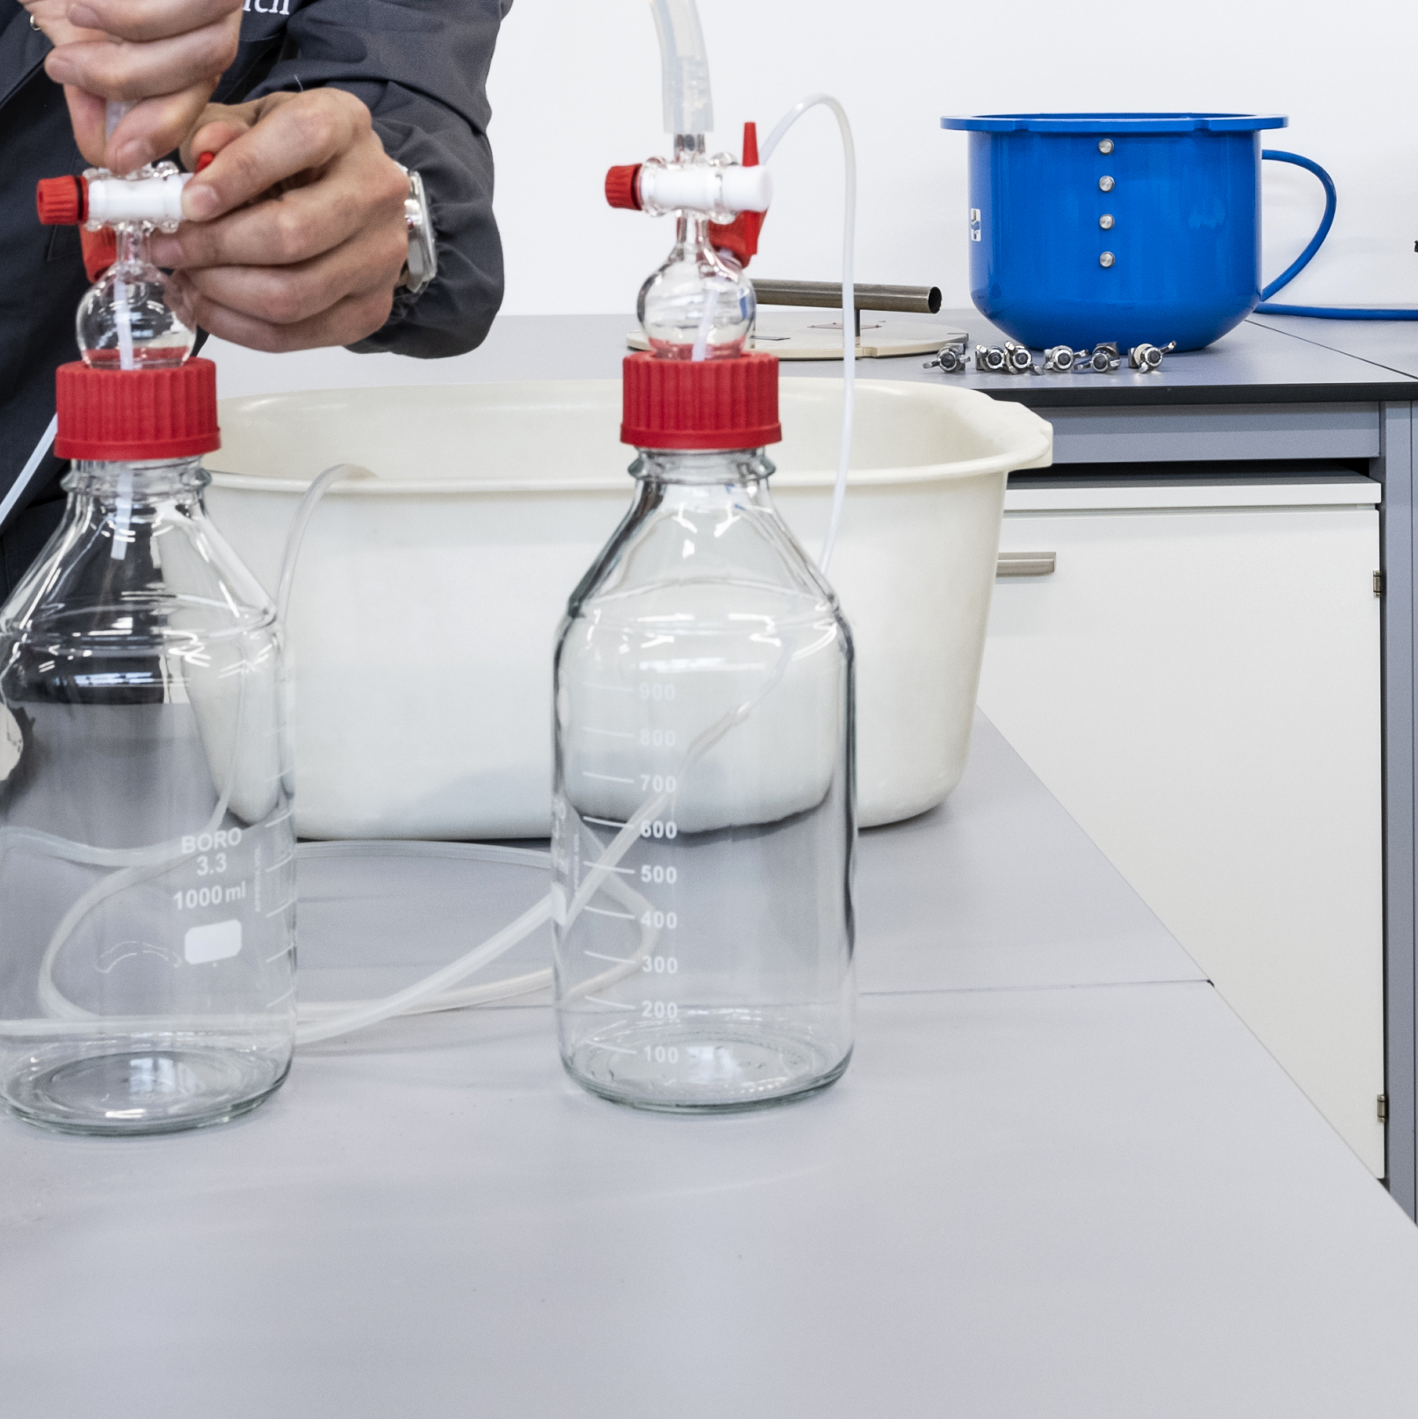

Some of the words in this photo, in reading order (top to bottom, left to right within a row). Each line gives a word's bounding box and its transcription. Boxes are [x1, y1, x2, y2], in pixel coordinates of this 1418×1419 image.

[640, 682, 676, 701] 900
[640, 774, 677, 793] 700
[640, 820, 678, 839] 600
[181, 827, 242, 854] BORO
[196, 853, 227, 876] 3.3
[640, 865, 678, 884] 500
[173, 885, 223, 910] 1000
[226, 881, 246, 902] ml
[641, 910, 678, 929] 400
[642, 956, 678, 974] 300
[642, 1000, 678, 1019] 200
[644, 1045, 679, 1064] 100
